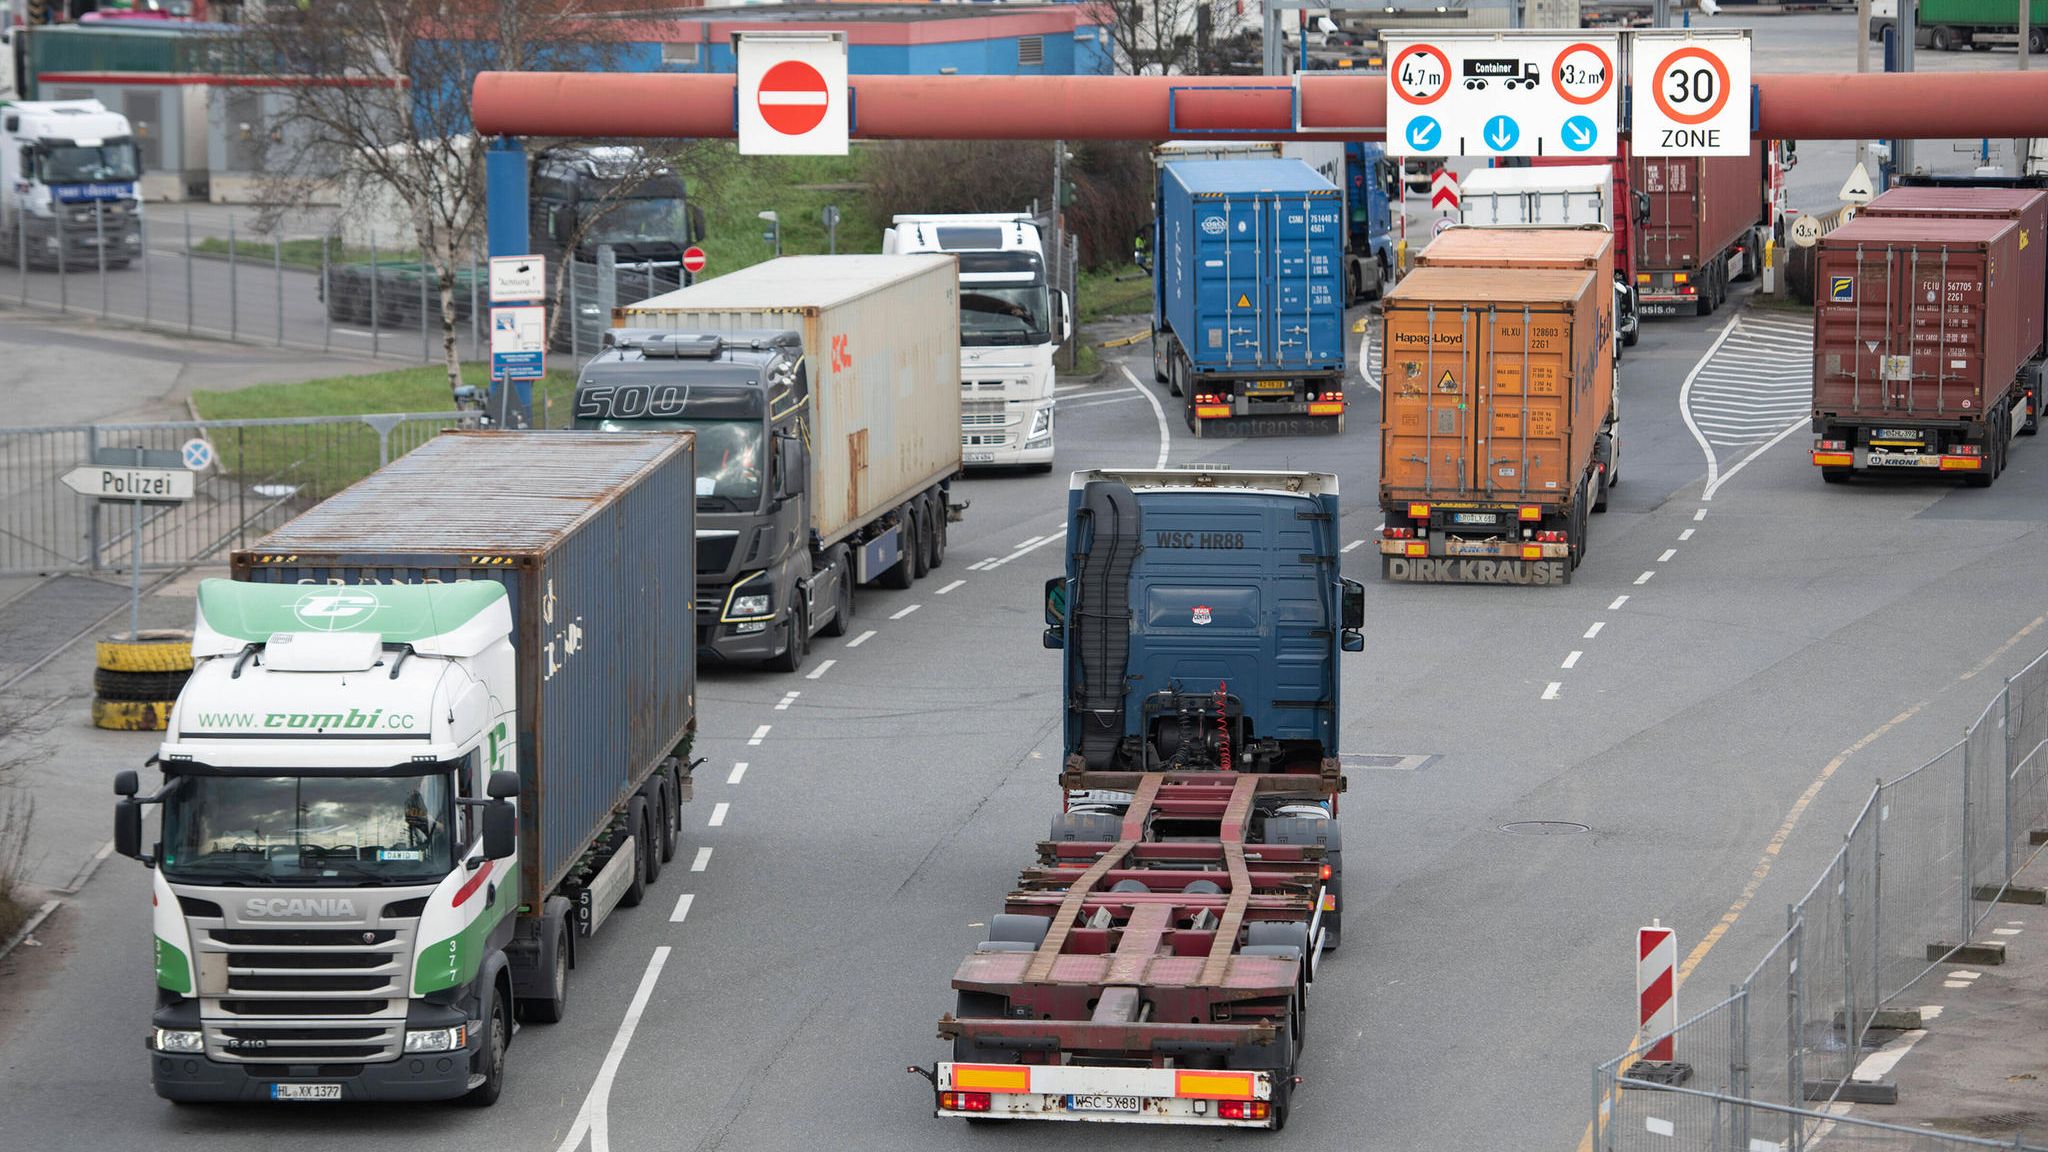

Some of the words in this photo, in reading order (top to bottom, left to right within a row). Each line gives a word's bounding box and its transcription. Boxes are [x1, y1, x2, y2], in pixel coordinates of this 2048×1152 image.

[1402, 62, 1426, 86] 4.7
[1428, 74, 1441, 85] m
[1475, 62, 1512, 73] Container
[1565, 64, 1586, 85] 3.2
[1588, 73, 1600, 84] m
[1669, 69, 1713, 103] 30
[1661, 129, 1721, 148] ZONE
[1923, 281, 1940, 290] FCIU
[1947, 281, 1972, 291] 567705
[1976, 282, 1982, 290] 7
[1947, 292, 1963, 301] 22G1
[1395, 332, 1463, 345] Hapag-Lloyd
[1501, 327, 1520, 336] HLXU
[1532, 327, 1558, 338] 128603
[1564, 328, 1569, 338] 5
[1531, 340, 1549, 348] 22G1
[577, 384, 689, 418] 500
[1884, 458, 1919, 466] KRONE
[102, 471, 170, 494] Polizei
[1156, 532, 1194, 549] WSC
[1200, 532, 1244, 550] HR88
[1389, 558, 1456, 583] DIRK
[1460, 559, 1564, 585] KRAUSE
[246, 898, 357, 917] SCANIA
[229, 1040, 239, 1048] R
[240, 1040, 265, 1048] 410
[277, 1086, 292, 1097] HL
[299, 1086, 312, 1097] XX
[314, 1085, 340, 1097] 1377
[1075, 1096, 1101, 1109] WSC
[1106, 1097, 1137, 1110] 5X88
